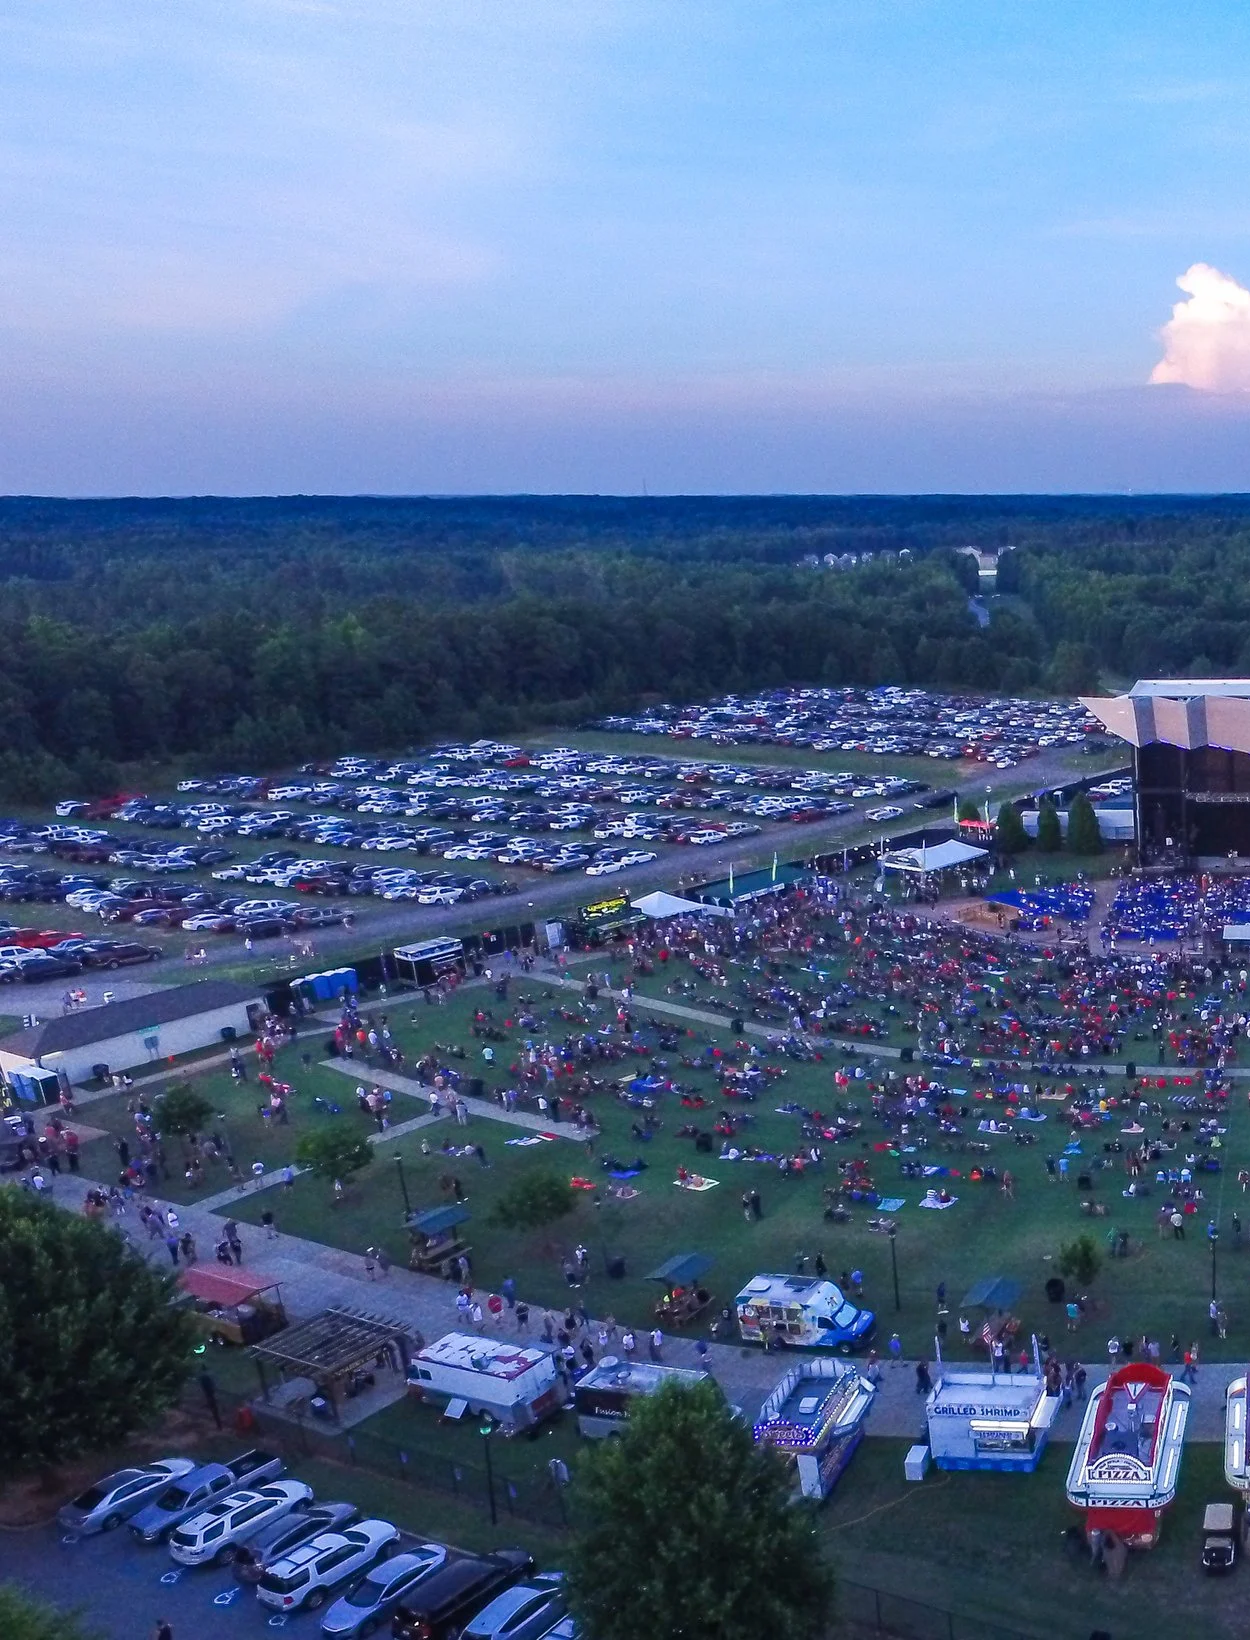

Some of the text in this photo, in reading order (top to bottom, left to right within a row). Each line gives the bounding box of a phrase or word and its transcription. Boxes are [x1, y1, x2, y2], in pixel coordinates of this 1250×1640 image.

[934, 1406, 1020, 1417] GRILLED SHRIMP
[1098, 1470, 1141, 1479] PIZZA
